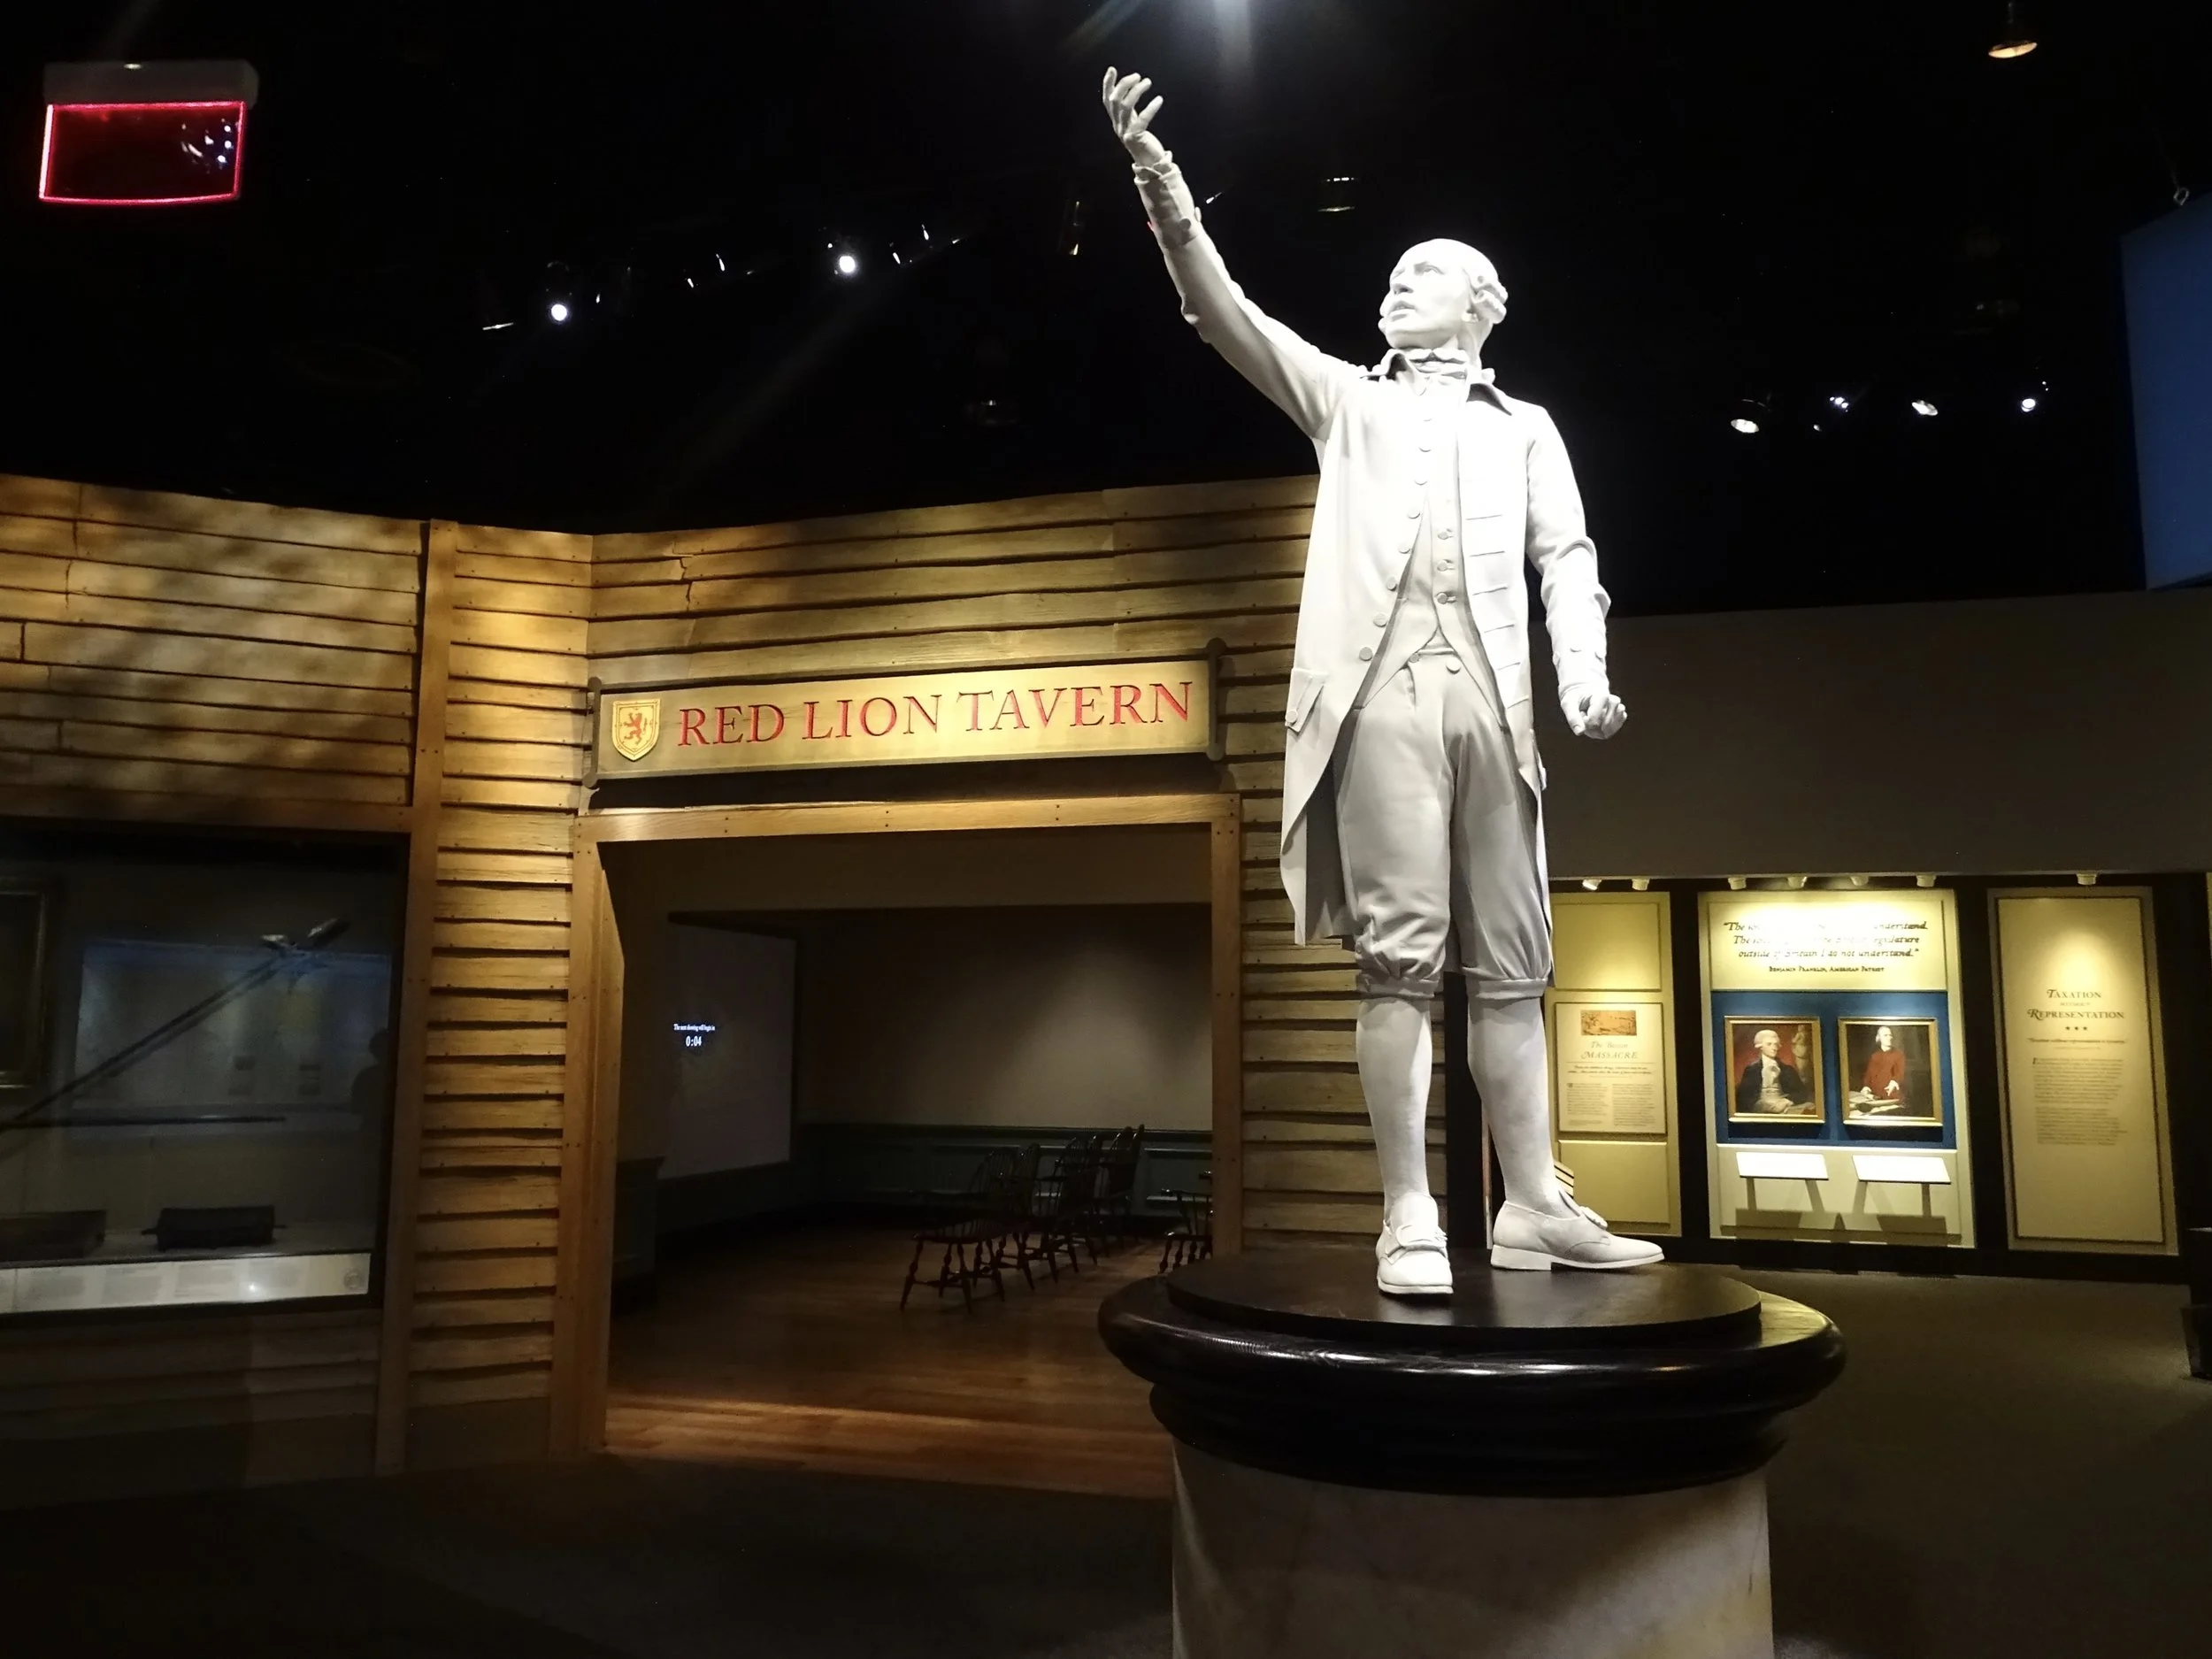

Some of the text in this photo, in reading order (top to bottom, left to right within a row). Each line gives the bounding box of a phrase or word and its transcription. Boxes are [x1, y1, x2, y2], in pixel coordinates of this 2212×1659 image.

[678, 680, 1194, 747] RED LION TAVERN
[1733, 935, 1750, 944] The
[2026, 1009, 2125, 1021] REPRESENTATION
[685, 1035, 703, 1047] 0:04
